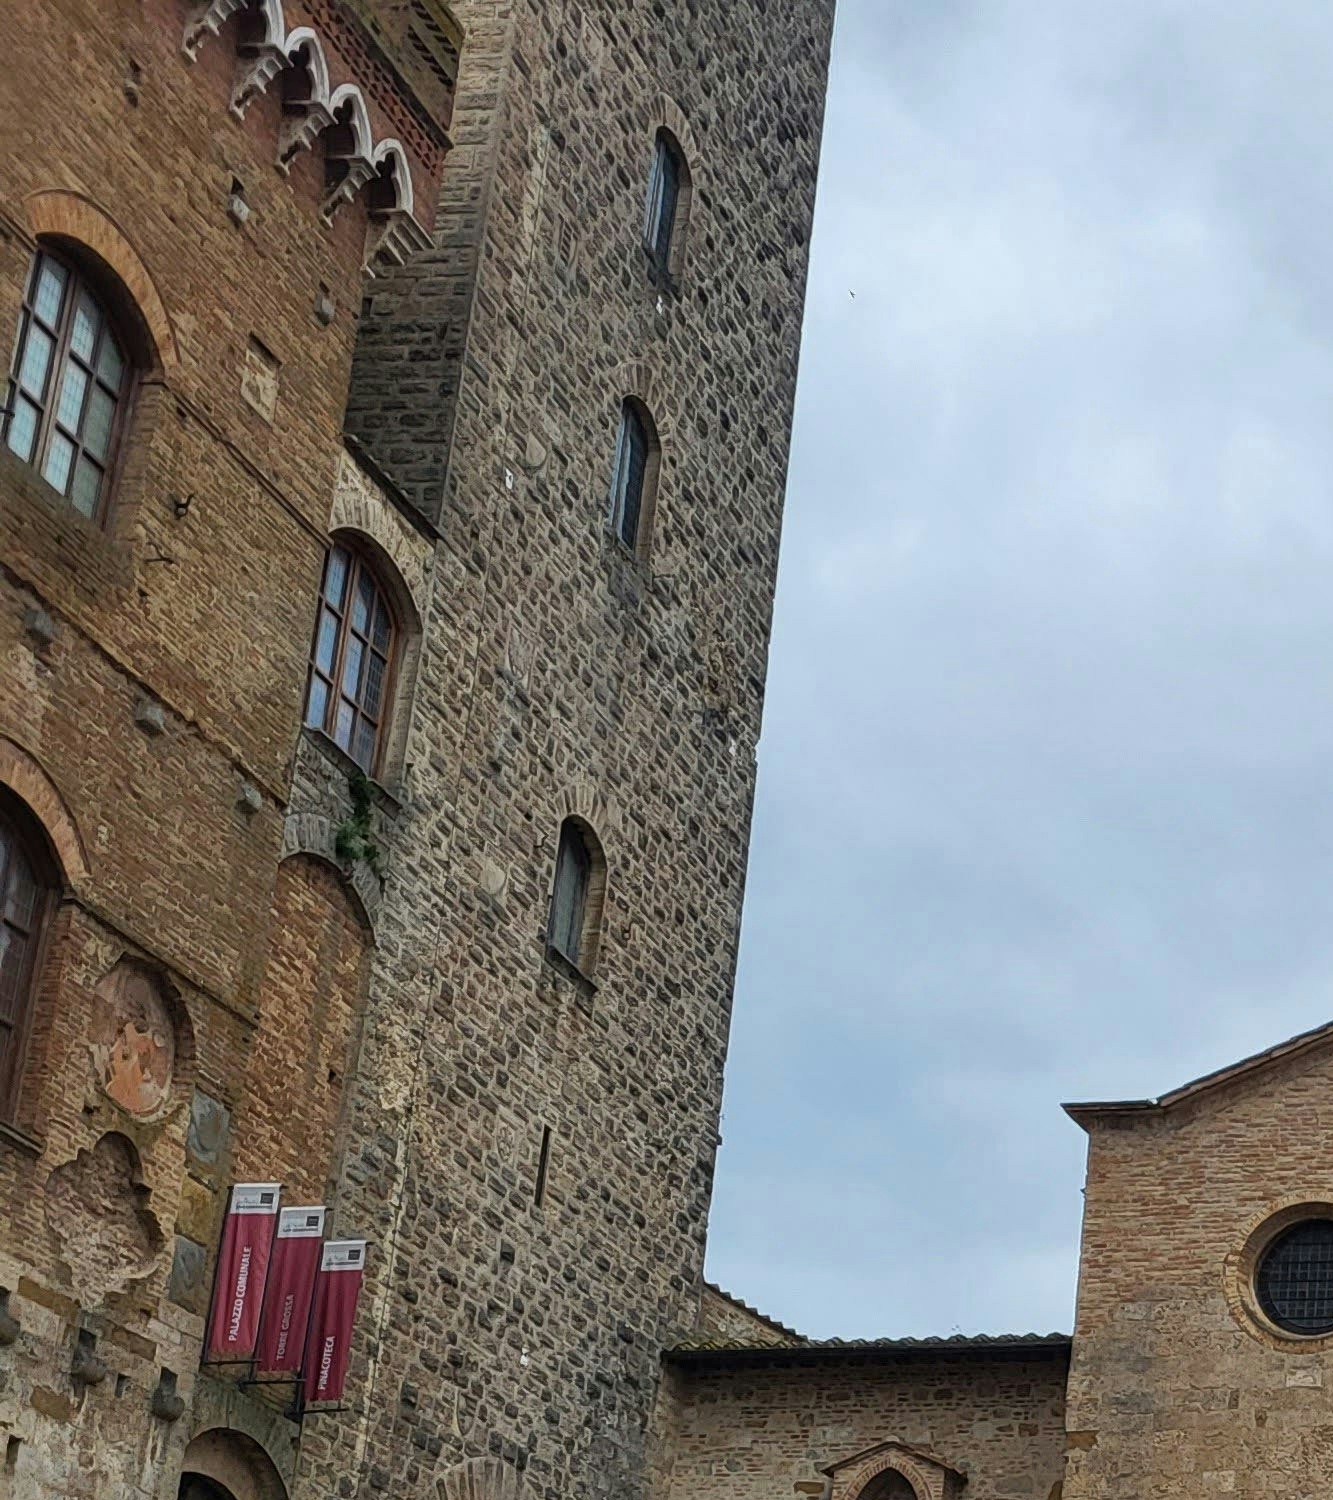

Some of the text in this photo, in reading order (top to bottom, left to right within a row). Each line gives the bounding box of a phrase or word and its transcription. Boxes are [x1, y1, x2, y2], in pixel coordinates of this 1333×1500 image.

[229, 1246, 252, 1341] PALAZZO COMUNALE
[318, 1336, 336, 1391] PINACOTECA
